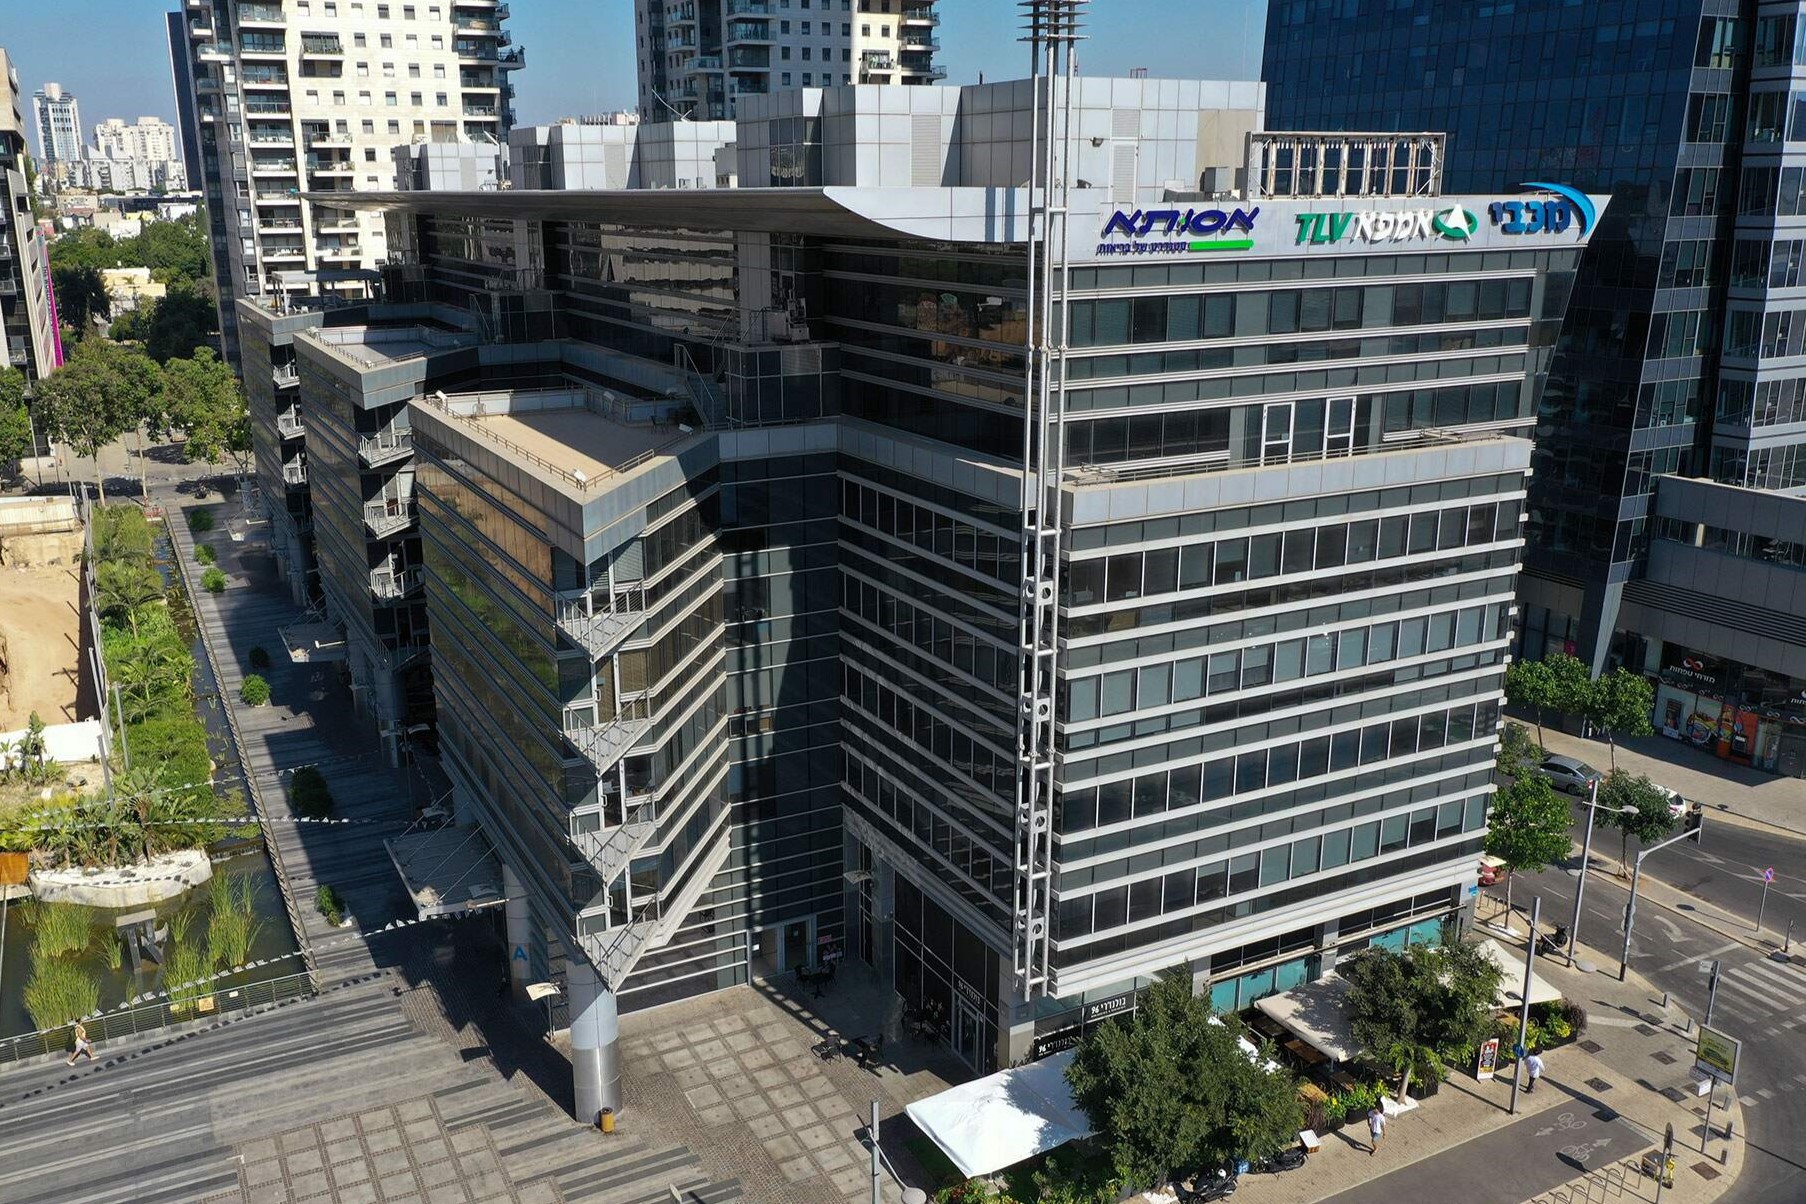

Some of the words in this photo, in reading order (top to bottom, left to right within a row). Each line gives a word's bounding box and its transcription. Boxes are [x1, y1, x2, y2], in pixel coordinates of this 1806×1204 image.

[1103, 206, 1260, 236] אסותא
[1296, 211, 1354, 244] TLV
[1355, 208, 1434, 242] אמפא
[1489, 200, 1572, 234] מכבי
[512, 944, 528, 961] A
